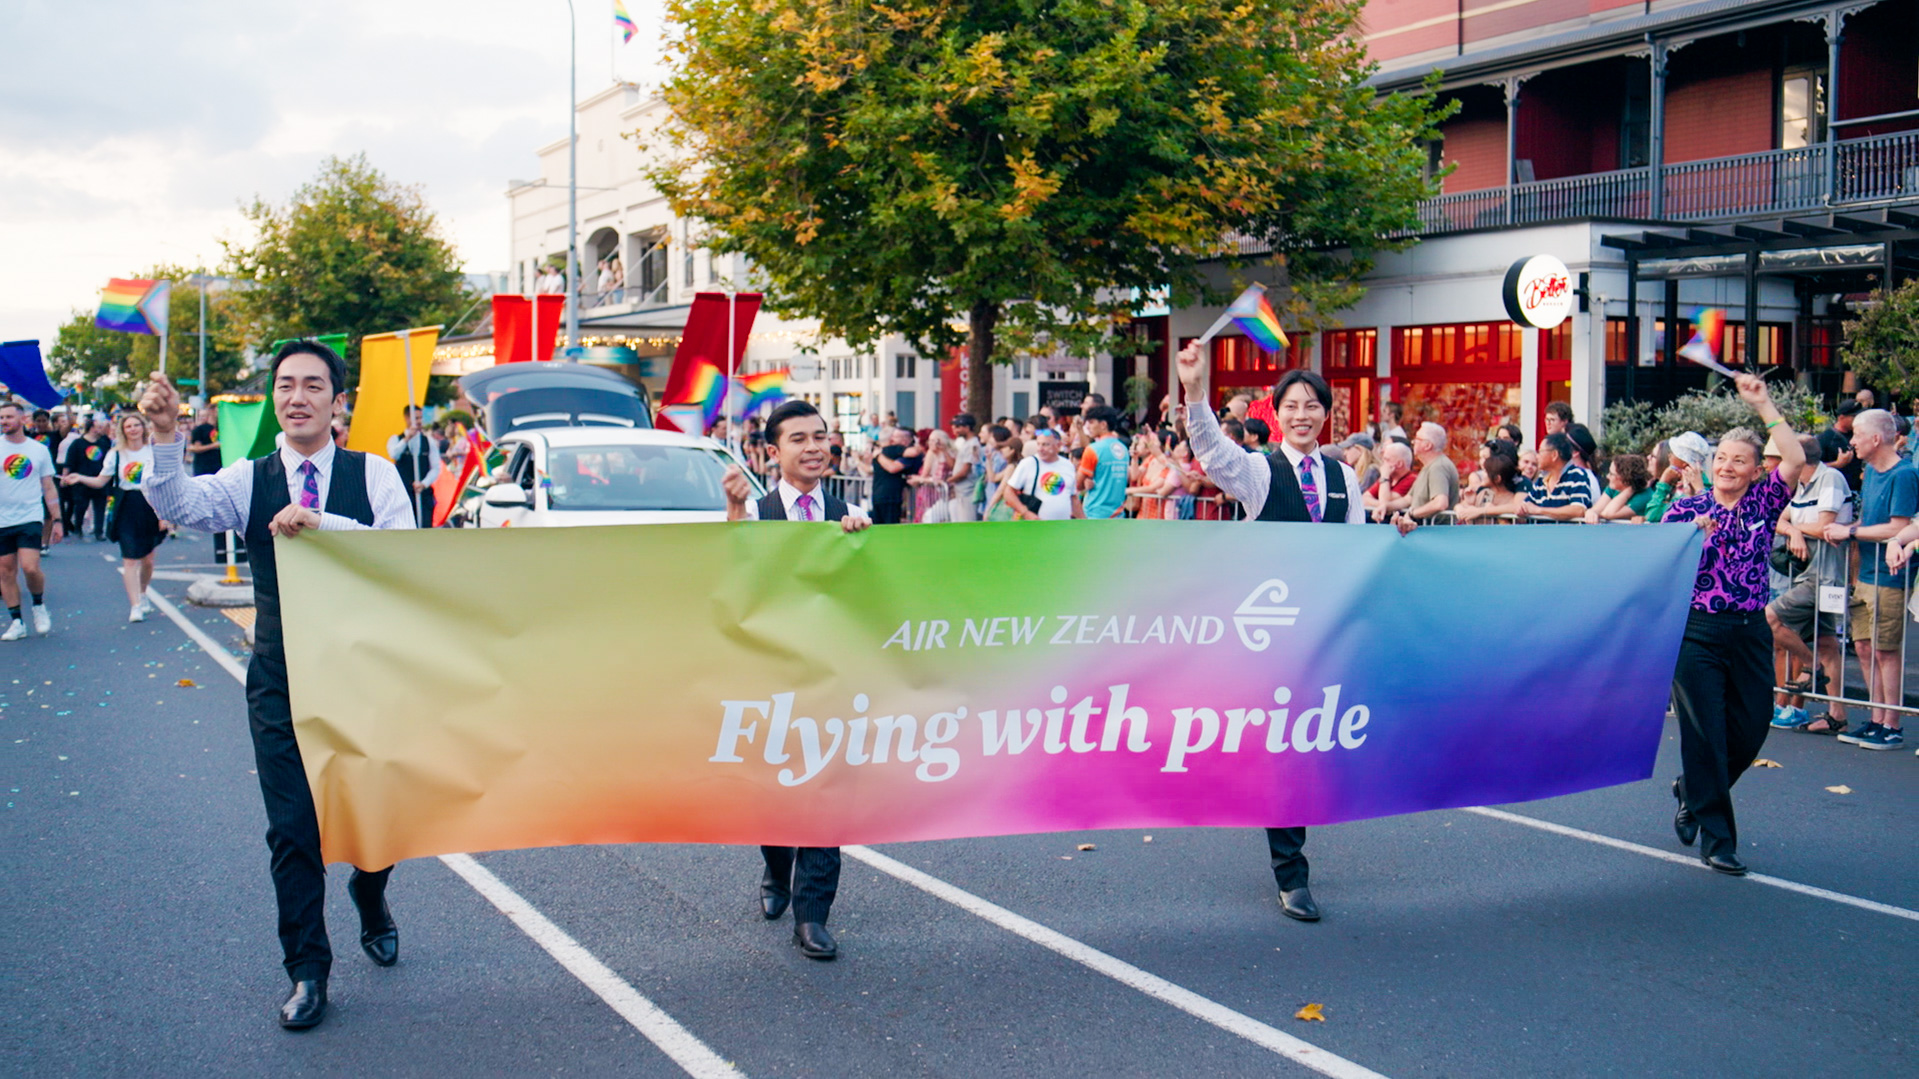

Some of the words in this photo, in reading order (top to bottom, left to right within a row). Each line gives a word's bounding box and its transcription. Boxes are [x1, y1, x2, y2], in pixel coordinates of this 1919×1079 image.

[1046, 390, 1083, 400] SWITCH
[882, 620, 949, 650] AIR
[958, 615, 1045, 648] NEW
[1048, 614, 1225, 645] ZEALAND
[708, 691, 968, 787] Flying
[977, 683, 1152, 757] with
[1160, 683, 1370, 773] pride
